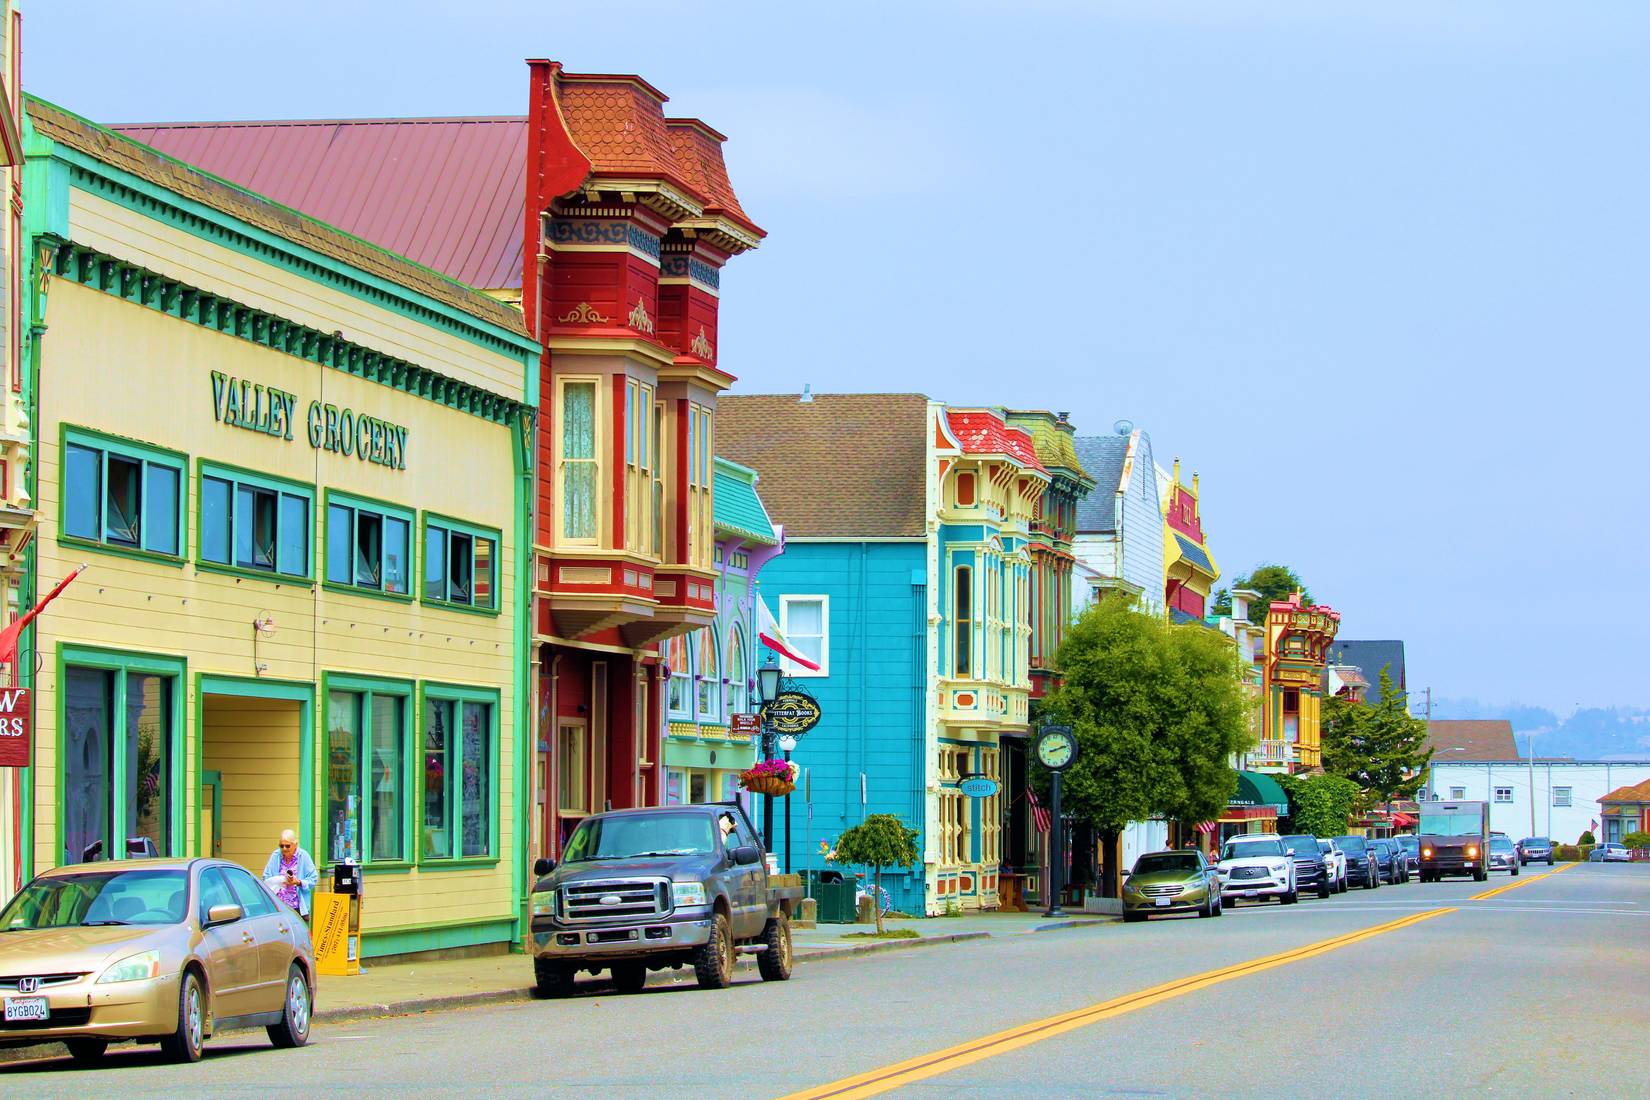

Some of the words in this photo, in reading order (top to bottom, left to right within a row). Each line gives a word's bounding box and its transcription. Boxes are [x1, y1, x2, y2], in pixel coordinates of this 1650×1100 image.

[211, 370, 297, 441] VALLEY
[308, 400, 409, 470] GROCERY
[968, 784, 990, 792] stitch
[7, 1005, 45, 1017] 8YGB024
